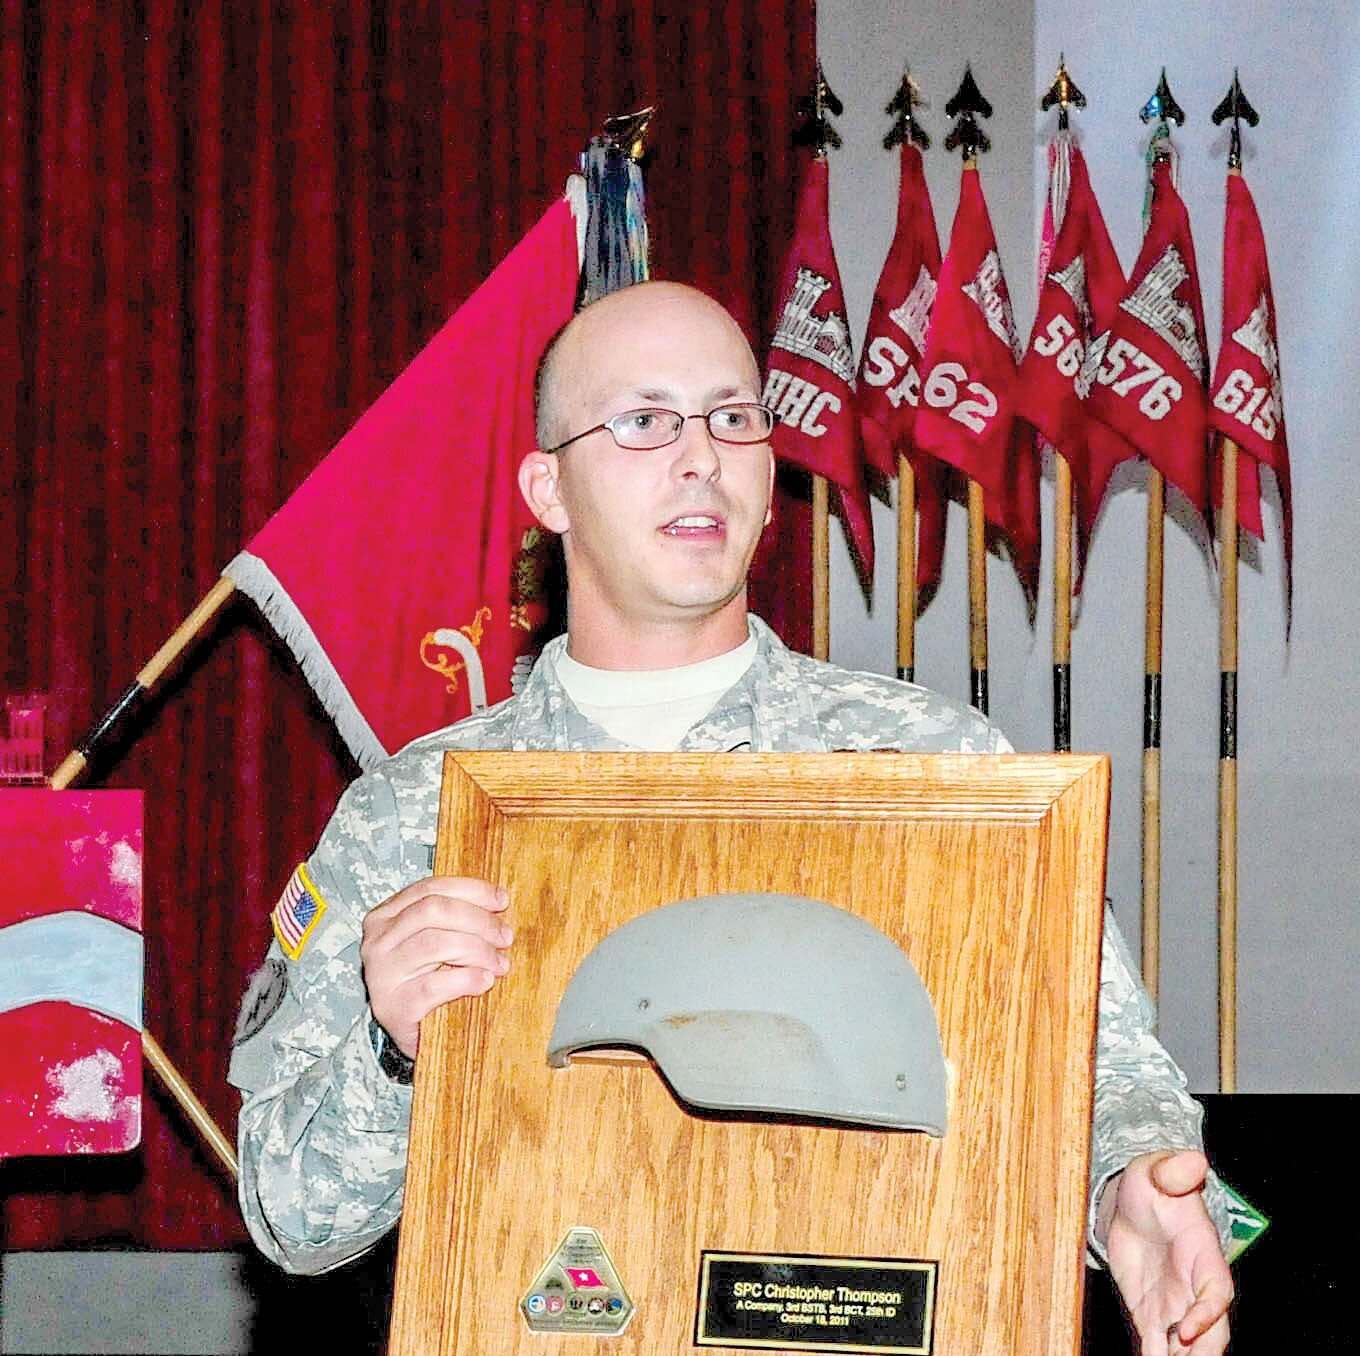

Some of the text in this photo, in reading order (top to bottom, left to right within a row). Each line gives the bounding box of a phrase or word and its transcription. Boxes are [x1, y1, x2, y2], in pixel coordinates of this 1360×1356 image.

[923, 362, 998, 435] 62
[1096, 338, 1183, 420] 576
[1213, 369, 1279, 441] 615
[733, 1281, 902, 1306] SPC Christopher Thompson
[736, 1300, 744, 1310] A
[885, 1307, 897, 1317] ID
[780, 1312, 815, 1324] October
[829, 1315, 850, 1325] 2011
